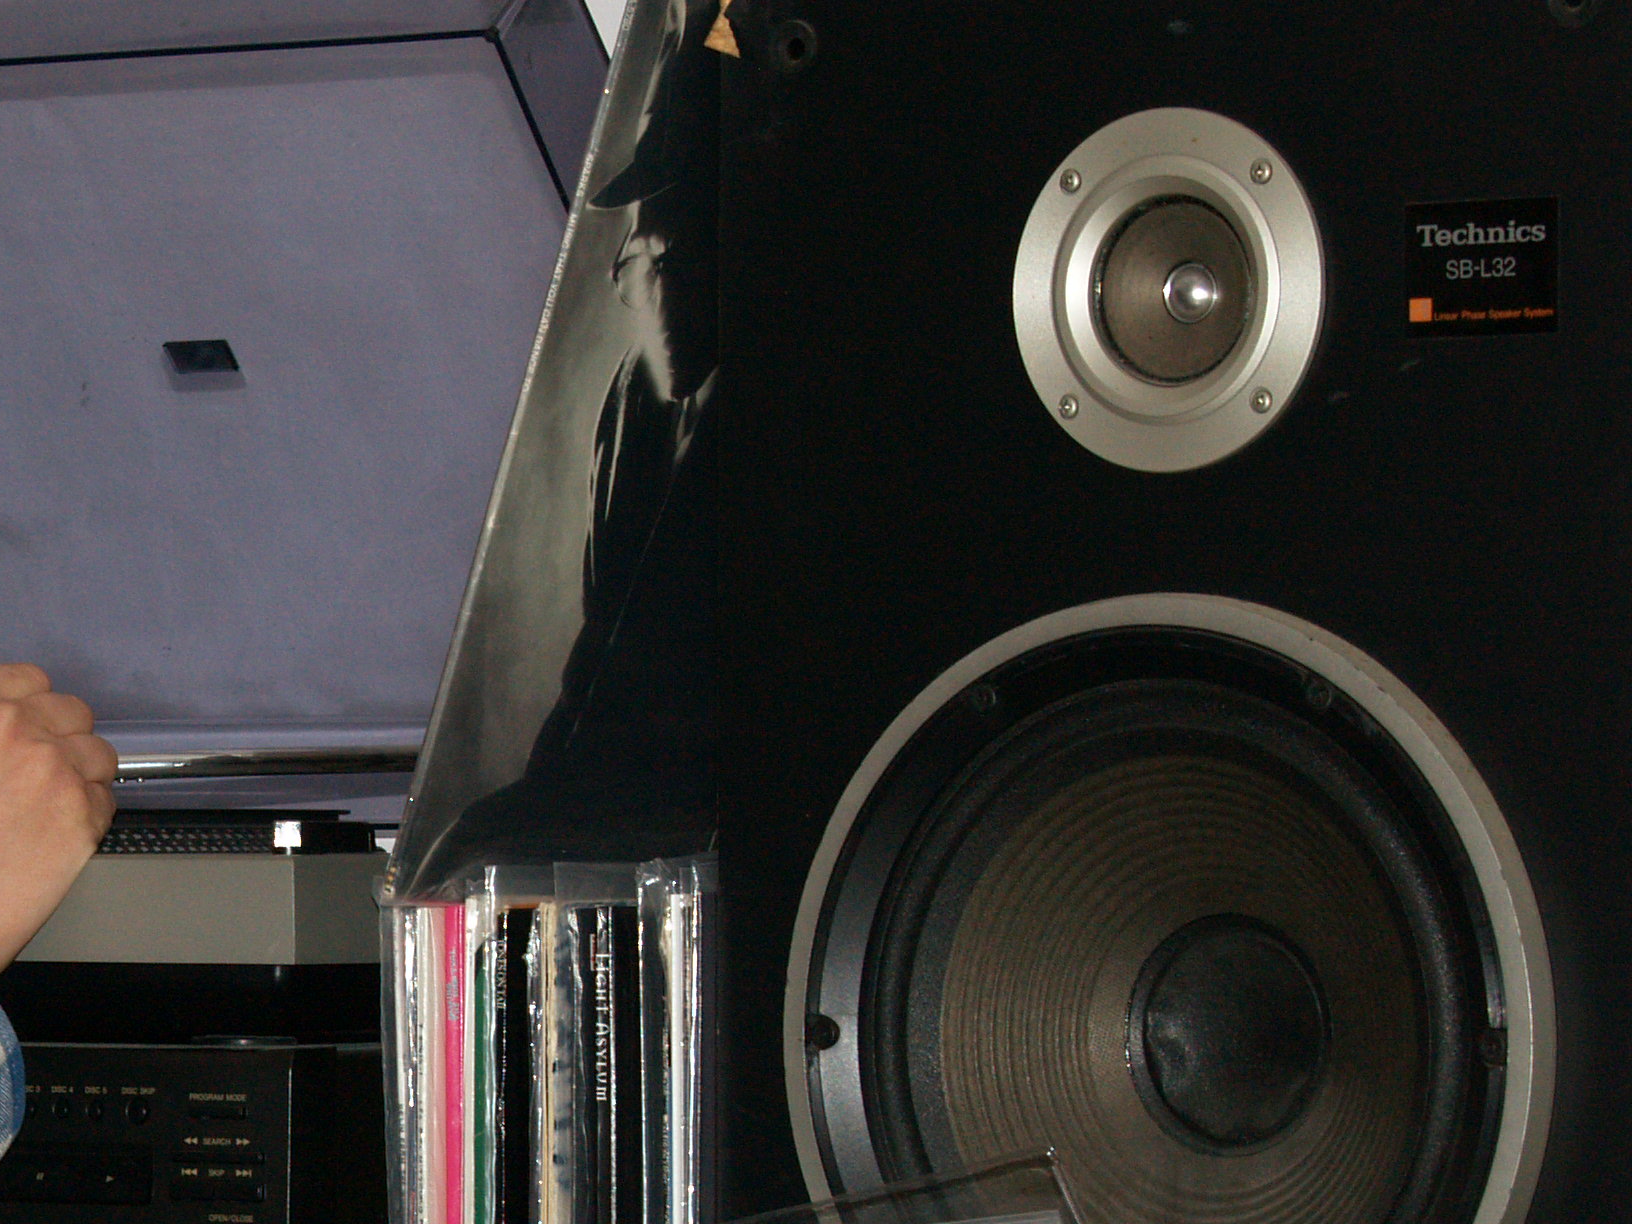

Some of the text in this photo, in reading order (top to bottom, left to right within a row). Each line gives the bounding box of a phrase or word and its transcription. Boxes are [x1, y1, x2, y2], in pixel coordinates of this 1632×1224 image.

[1416, 220, 1546, 247] Technics
[552, 250, 566, 280] THAT
[1445, 256, 1517, 281] SB-L32
[545, 282, 557, 307] YOU
[537, 307, 551, 333] CAN
[1461, 310, 1487, 320] Phase
[1488, 308, 1522, 320] Speaker
[1523, 307, 1556, 320] System
[526, 334, 543, 374] DANCE
[522, 377, 531, 393] TO
[51, 1086, 68, 1094] DISC
[189, 1092, 247, 1102] PROGRAM MODE
[202, 1137, 231, 1146] SEARCH
[208, 1168, 225, 1177] SKIP
[208, 1213, 254, 1223] OPEN/CLOSE
